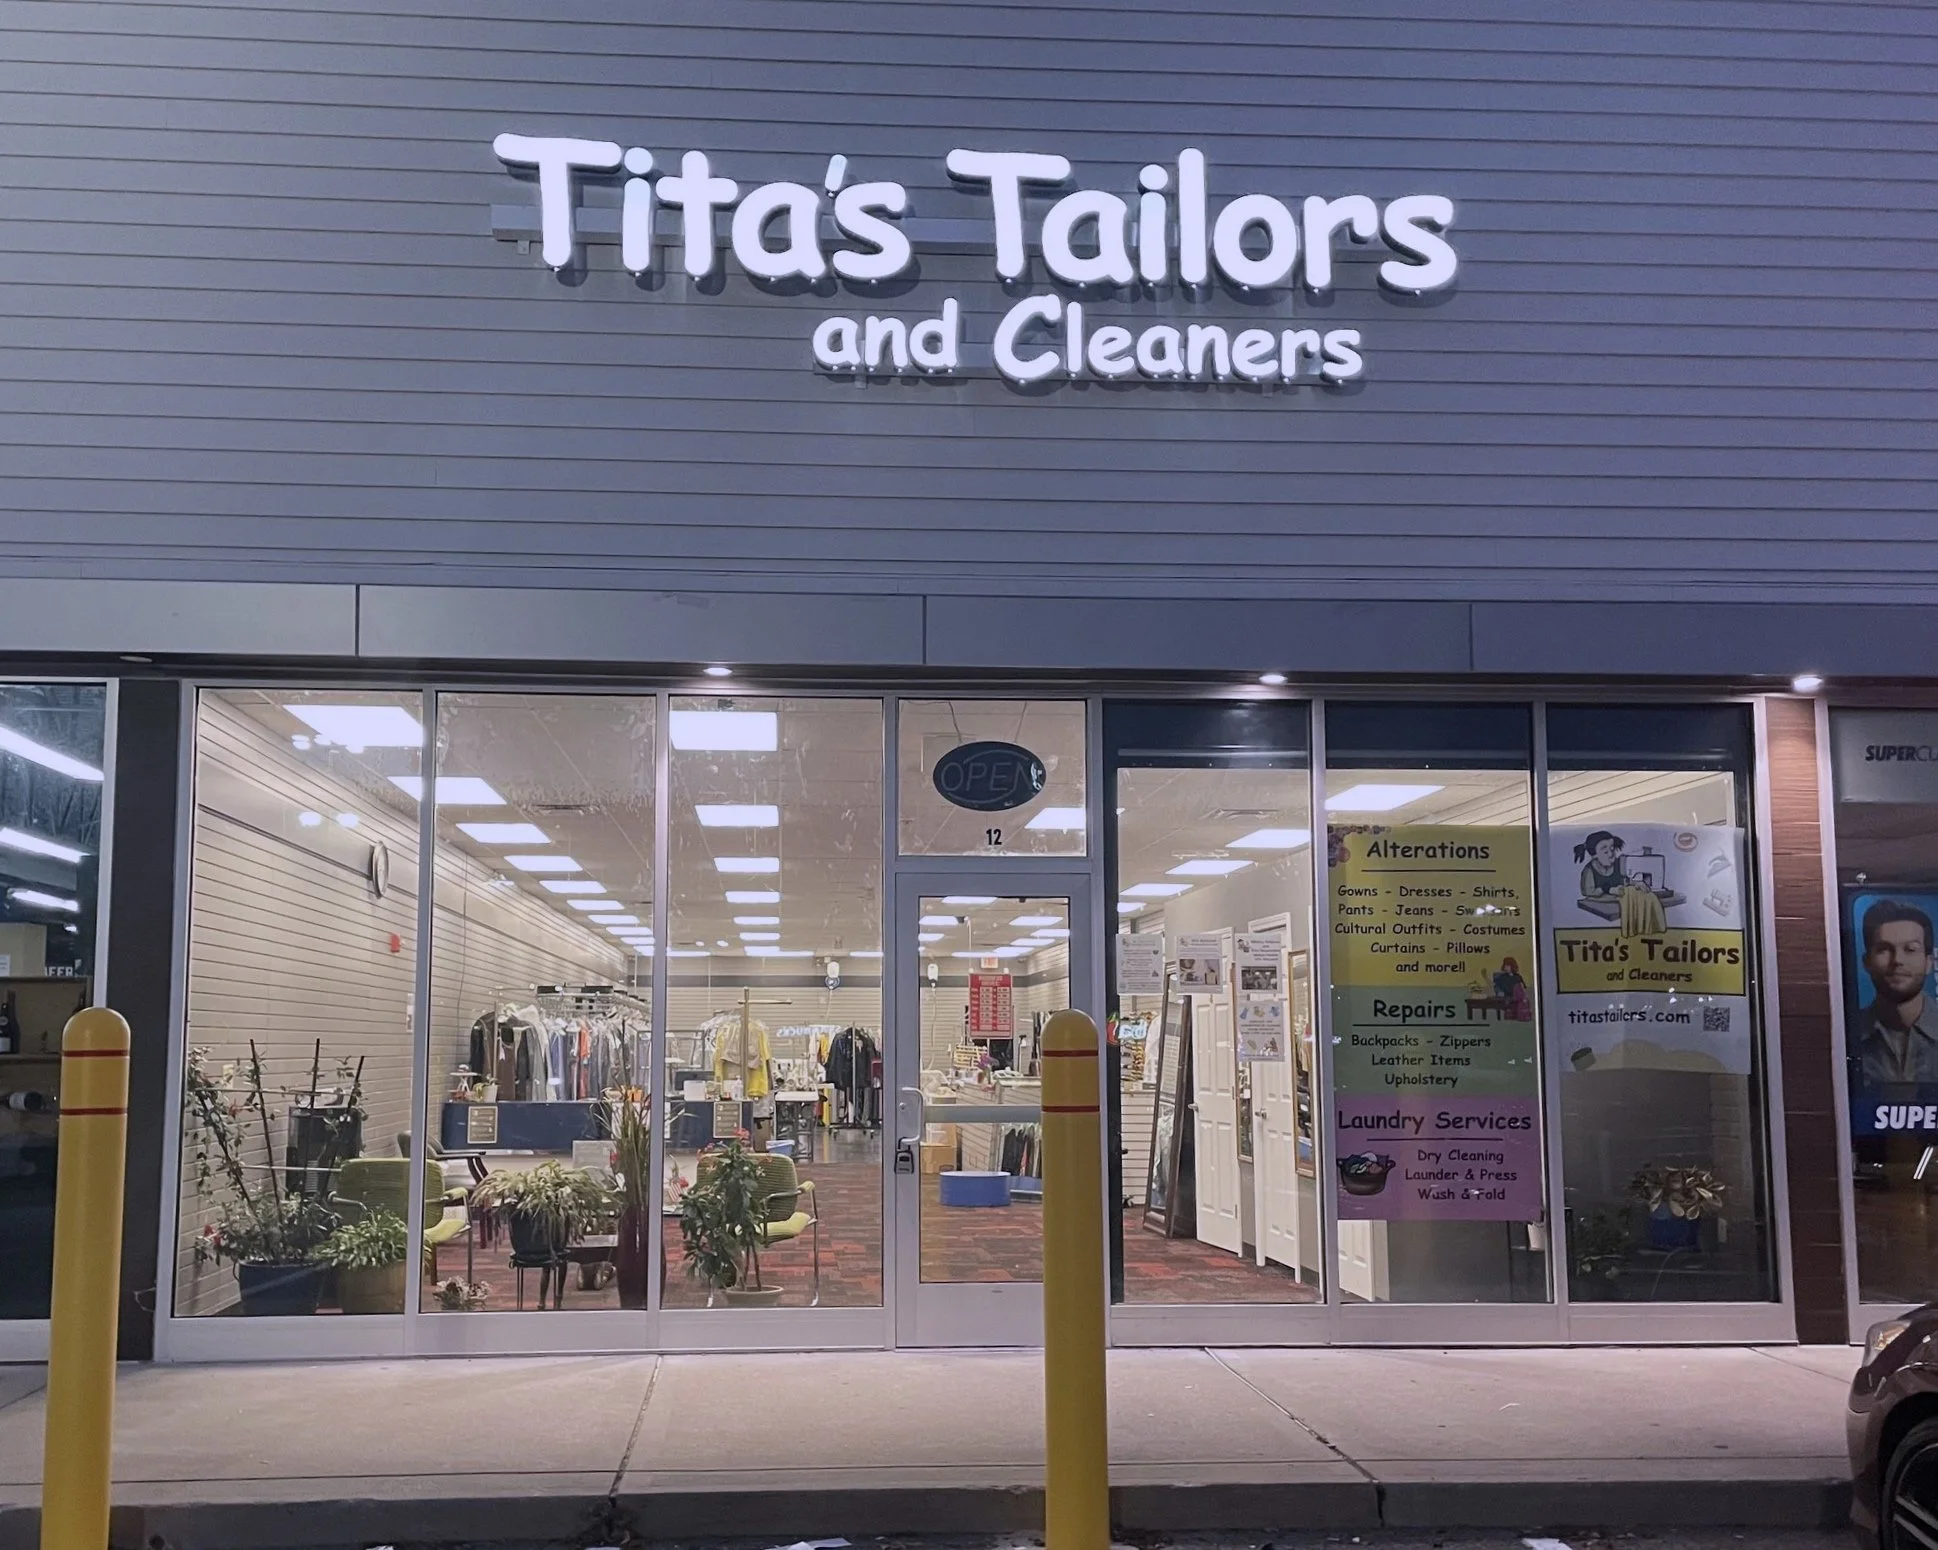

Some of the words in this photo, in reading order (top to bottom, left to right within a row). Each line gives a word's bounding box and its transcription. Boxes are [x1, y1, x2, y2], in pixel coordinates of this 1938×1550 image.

[493, 133, 911, 279] Tita's
[945, 147, 1457, 290] Tailors
[812, 297, 958, 368] and
[993, 294, 1363, 380] Cleaners
[940, 761, 1037, 792] OPEN
[986, 828, 1003, 846] 12
[1366, 839, 1490, 860] Alterations
[1337, 884, 1378, 897] Gowns
[1399, 885, 1452, 897] Dresses
[1472, 886, 1519, 900] Shirts,
[1338, 903, 1374, 916] Pants
[1395, 904, 1434, 916] Jeans
[1334, 922, 1385, 935] Cultural
[1392, 923, 1442, 935] Outfits
[1463, 923, 1526, 936] Costumes
[1370, 942, 1426, 954] Curtains
[1446, 942, 1490, 954] Pillows
[1559, 938, 1630, 963] Tita's
[1640, 938, 1740, 965] Tailors
[1396, 961, 1419, 973] and
[1425, 961, 1466, 973] more!!
[1606, 968, 1625, 981] and
[1628, 968, 1693, 982] Cleaners
[1373, 999, 1456, 1023] Repairs
[1567, 1008, 1691, 1024] titastailors.com
[1351, 1034, 1419, 1049] Backpacks
[1439, 1035, 1491, 1049] Zippers
[1371, 1054, 1424, 1066] Leather
[1430, 1054, 1471, 1066] Items
[1384, 1073, 1458, 1088] Upholstery
[1338, 1110, 1424, 1135] Laundry
[1435, 1111, 1532, 1130] Services
[1874, 1105, 1938, 1130] SUPE
[1417, 1149, 1442, 1165] Dry
[1448, 1149, 1504, 1165] Cleaning
[1405, 1168, 1459, 1181] Launder
[1465, 1169, 1475, 1181] &
[1480, 1169, 1517, 1181] Press
[1417, 1187, 1455, 1200] Wash
[1460, 1188, 1471, 1200] &
[1475, 1188, 1506, 1200] Fold
